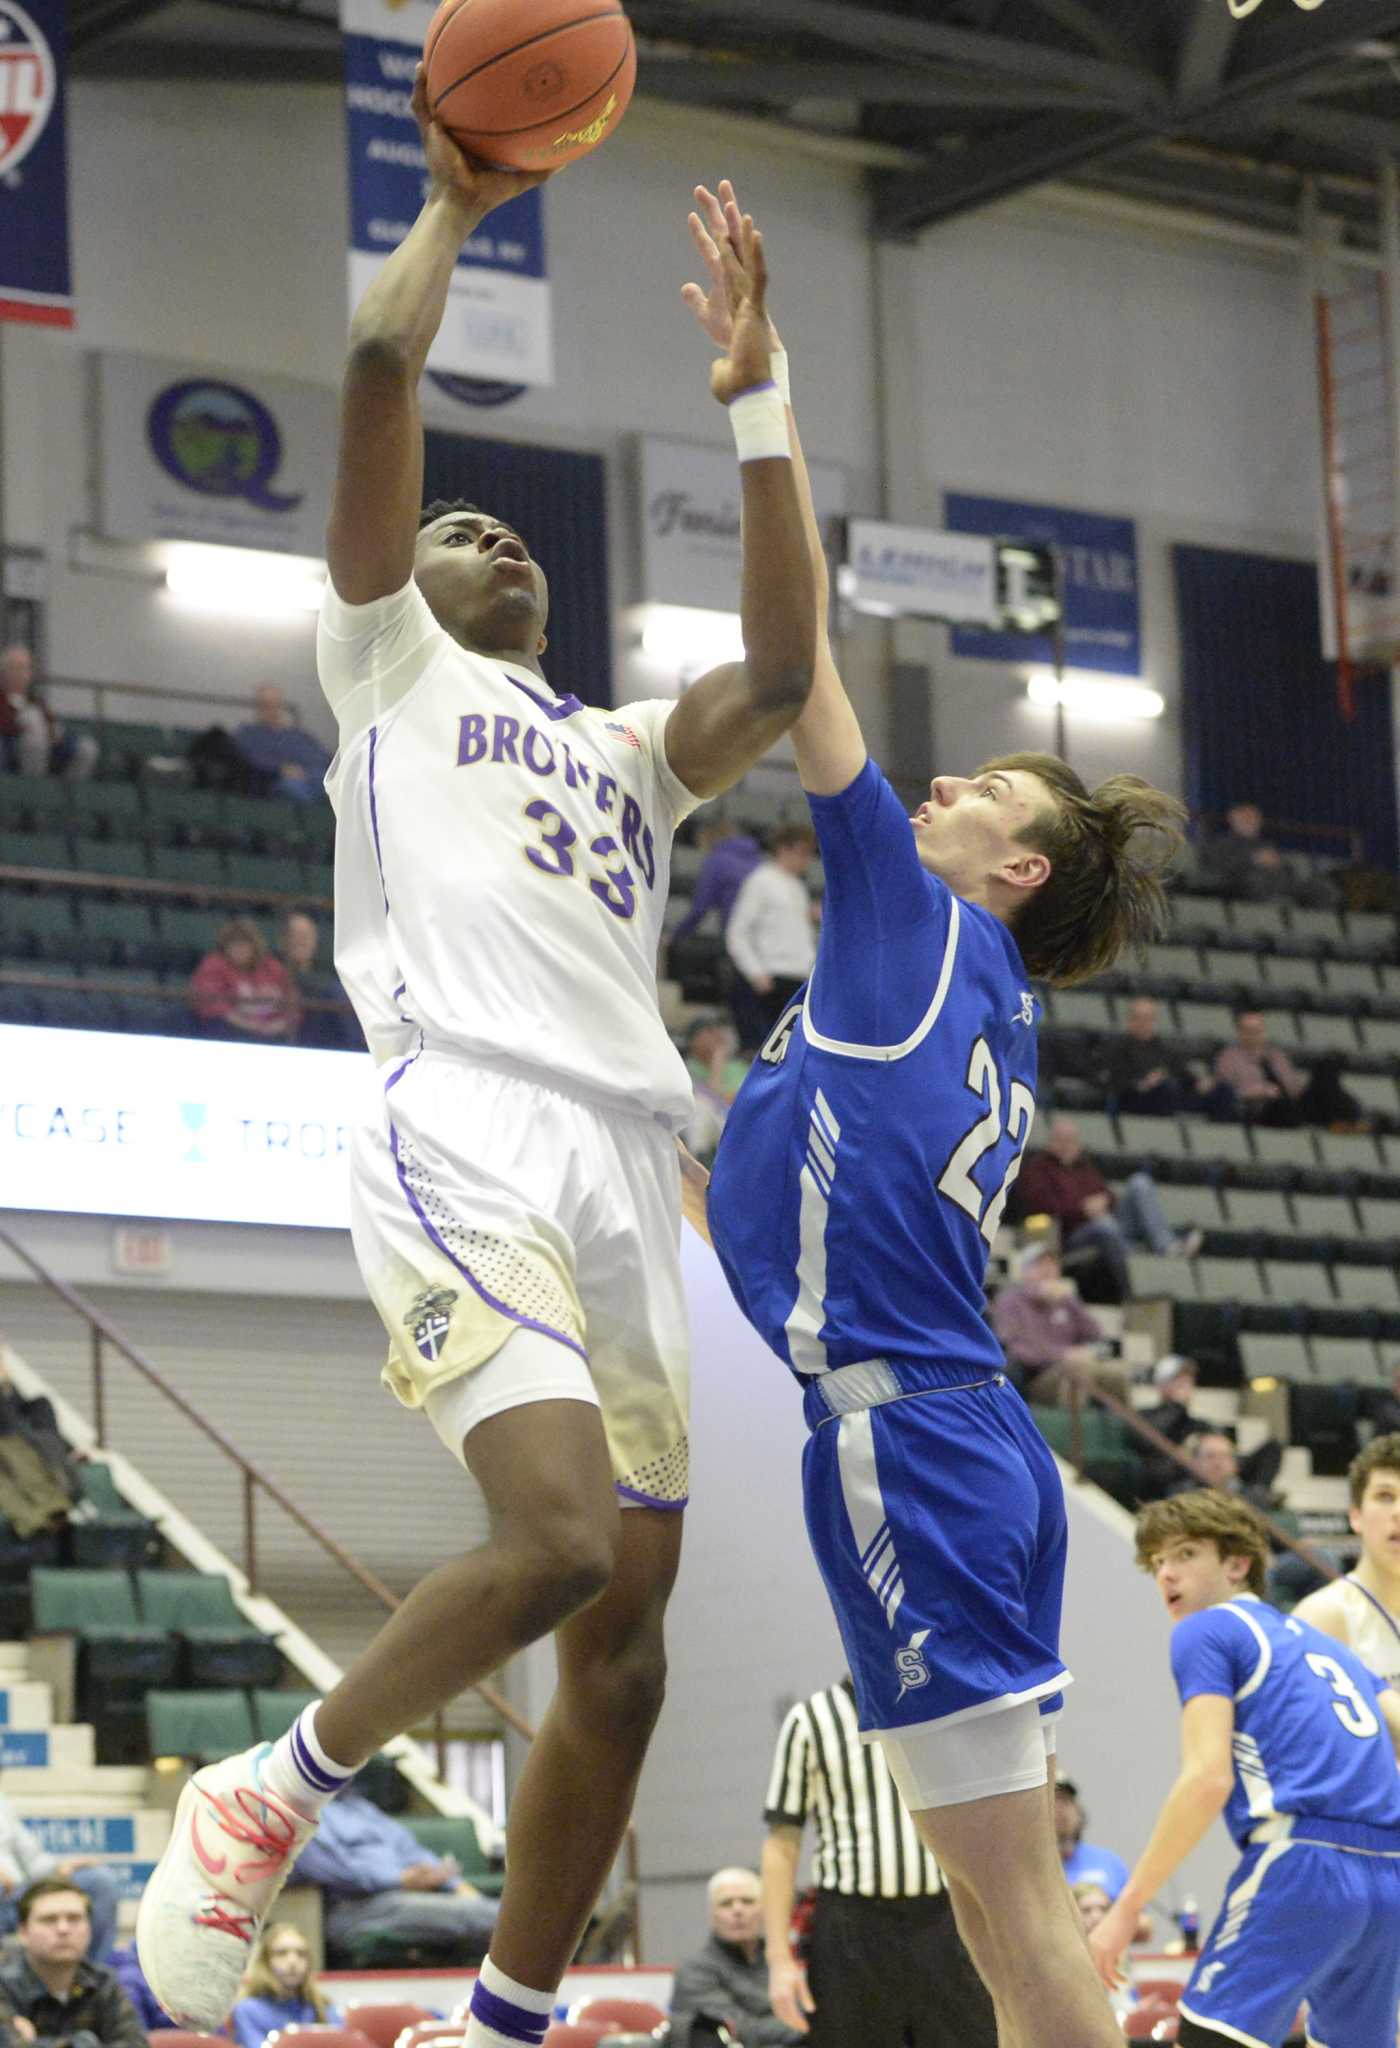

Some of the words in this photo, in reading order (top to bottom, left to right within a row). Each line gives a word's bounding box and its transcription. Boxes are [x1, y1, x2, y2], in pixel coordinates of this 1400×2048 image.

[524, 796, 637, 920] 33
[0, 1103, 137, 1144] CASE
[937, 1033, 1036, 1249] 22
[895, 1647, 931, 1690] S
[1303, 1651, 1380, 1739] 3
